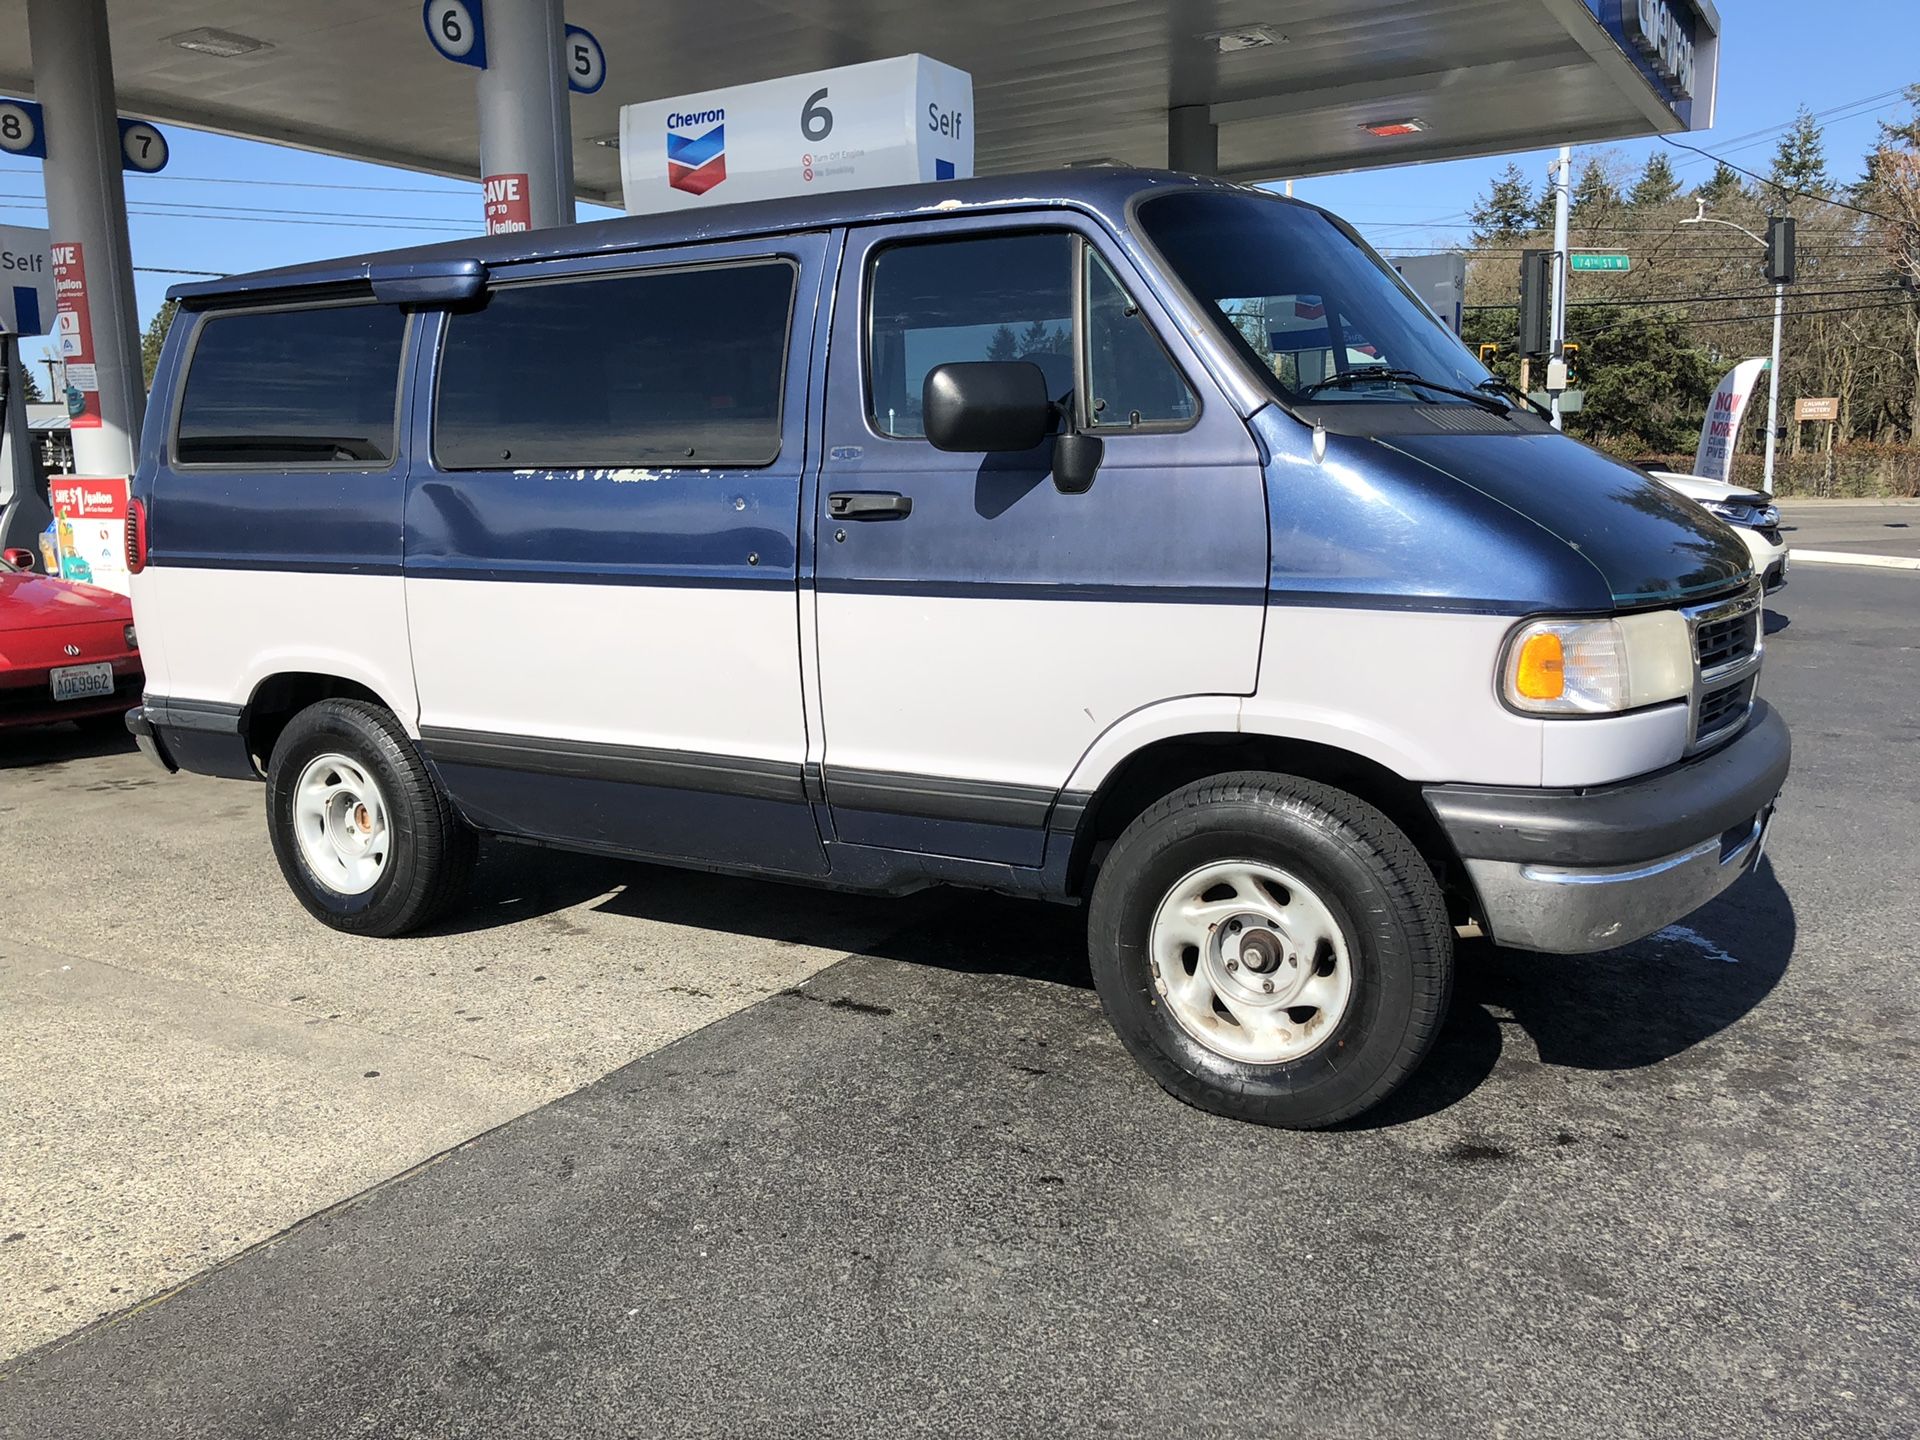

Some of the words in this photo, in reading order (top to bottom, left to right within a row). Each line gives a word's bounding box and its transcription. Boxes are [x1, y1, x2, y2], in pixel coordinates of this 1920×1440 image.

[441, 10, 462, 42] 6
[574, 45, 591, 75] 5
[667, 108, 725, 129] Chevron
[800, 87, 833, 142] 6
[929, 102, 962, 140] Self
[2, 114, 22, 140] 8
[135, 135, 151, 158] 7
[497, 204, 508, 214] TO
[2, 251, 43, 273] Self
[52, 246, 76, 266] AVE
[1602, 258, 1612, 268] ST
[1715, 392, 1742, 412] NOW
[55, 489, 70, 503] SAVE
